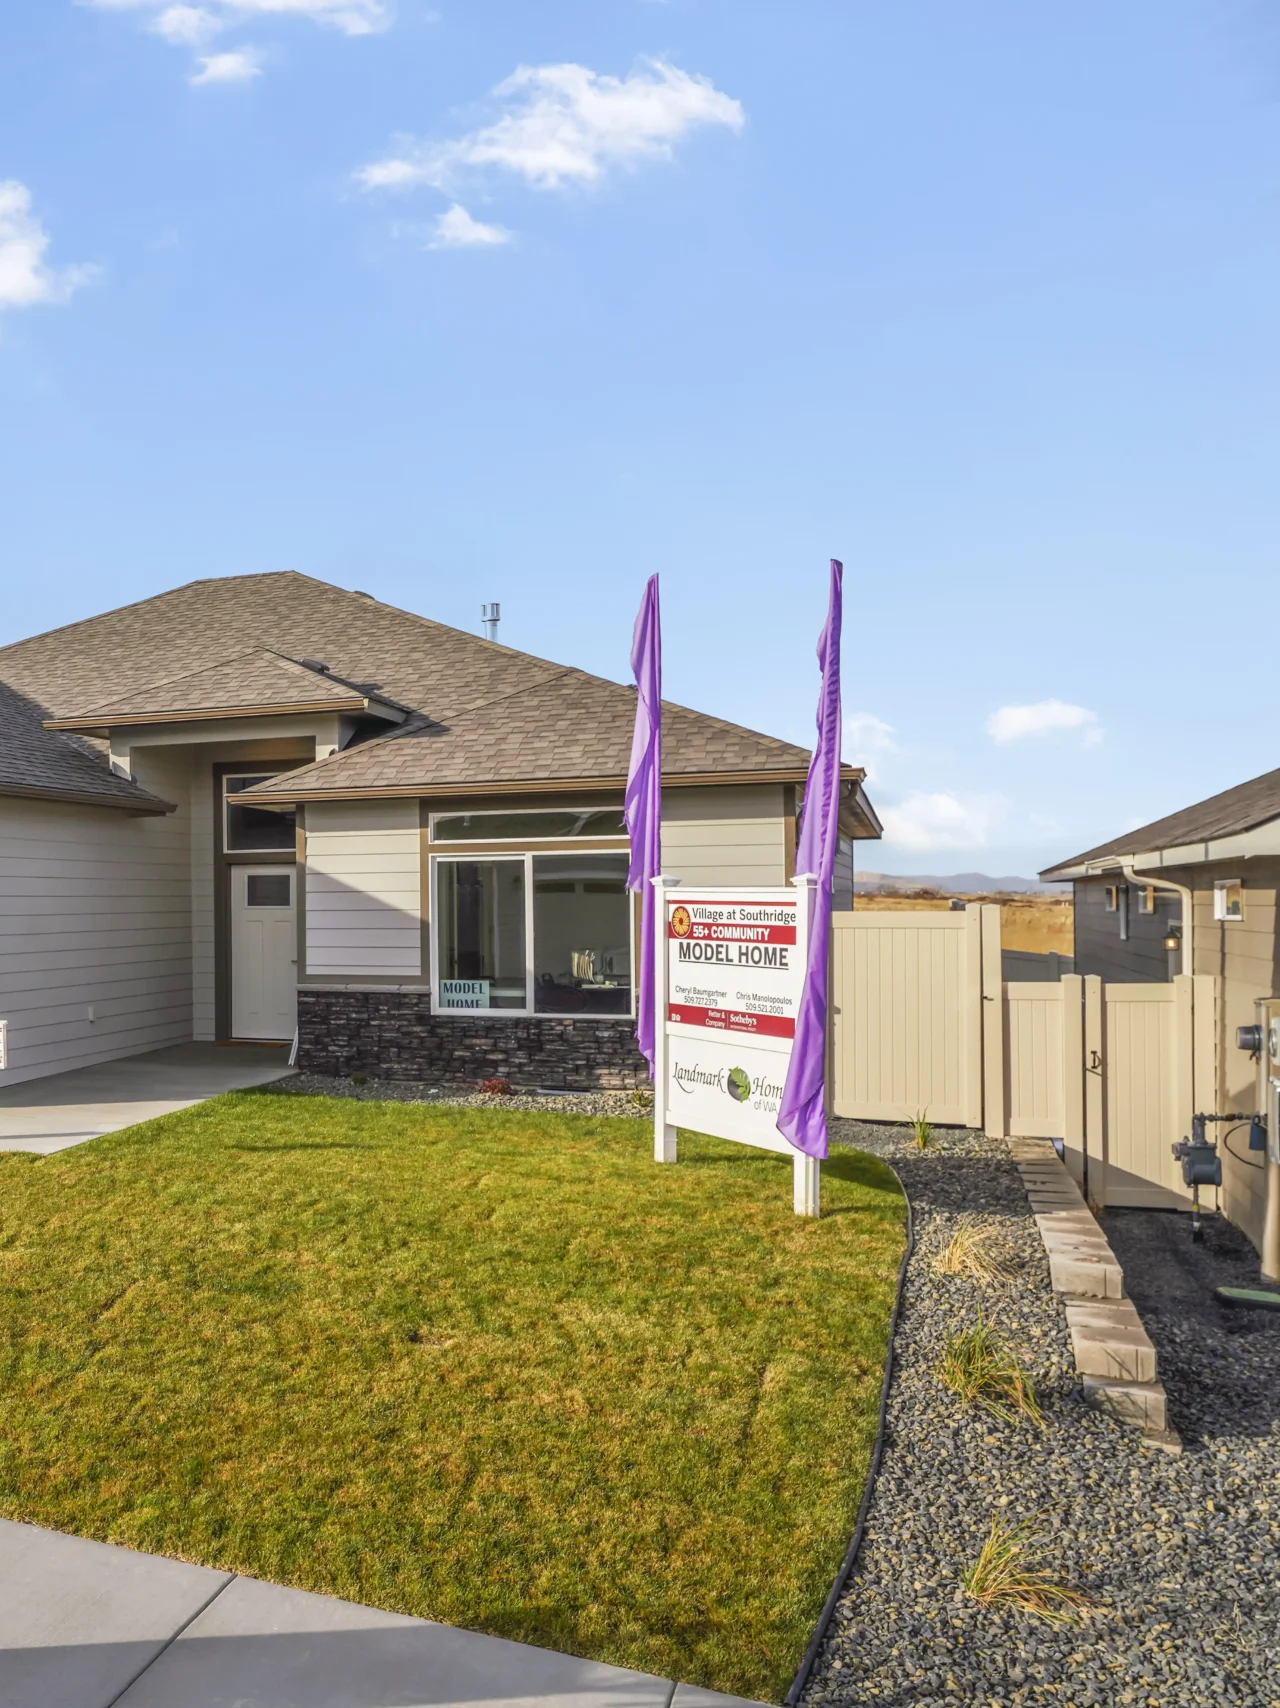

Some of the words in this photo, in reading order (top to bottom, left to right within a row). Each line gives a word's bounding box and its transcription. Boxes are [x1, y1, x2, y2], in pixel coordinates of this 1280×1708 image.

[692, 907, 724, 922] Village
[726, 909, 737, 920] at
[739, 908, 797, 925] Southridge
[692, 925, 709, 938] 55+
[710, 926, 771, 941] COMMUNITY
[678, 941, 734, 963] MODEL
[738, 944, 789, 967] HOME
[443, 982, 486, 994] MODEL
[675, 985, 692, 996] Cheryl
[693, 986, 728, 999] Baumgartner
[447, 999, 483, 1008] HOME
[684, 995, 718, 1007] 509.727.2379
[736, 991, 751, 1001] Chris
[752, 993, 793, 1005] Manolopoulos
[745, 1002, 784, 1015] 509.521.2001
[705, 1018, 726, 1029] Company
[729, 1013, 757, 1027] Sotheby's
[672, 1062, 726, 1094] Landmark
[751, 1075, 783, 1100] Hom
[754, 1099, 762, 1110] of
